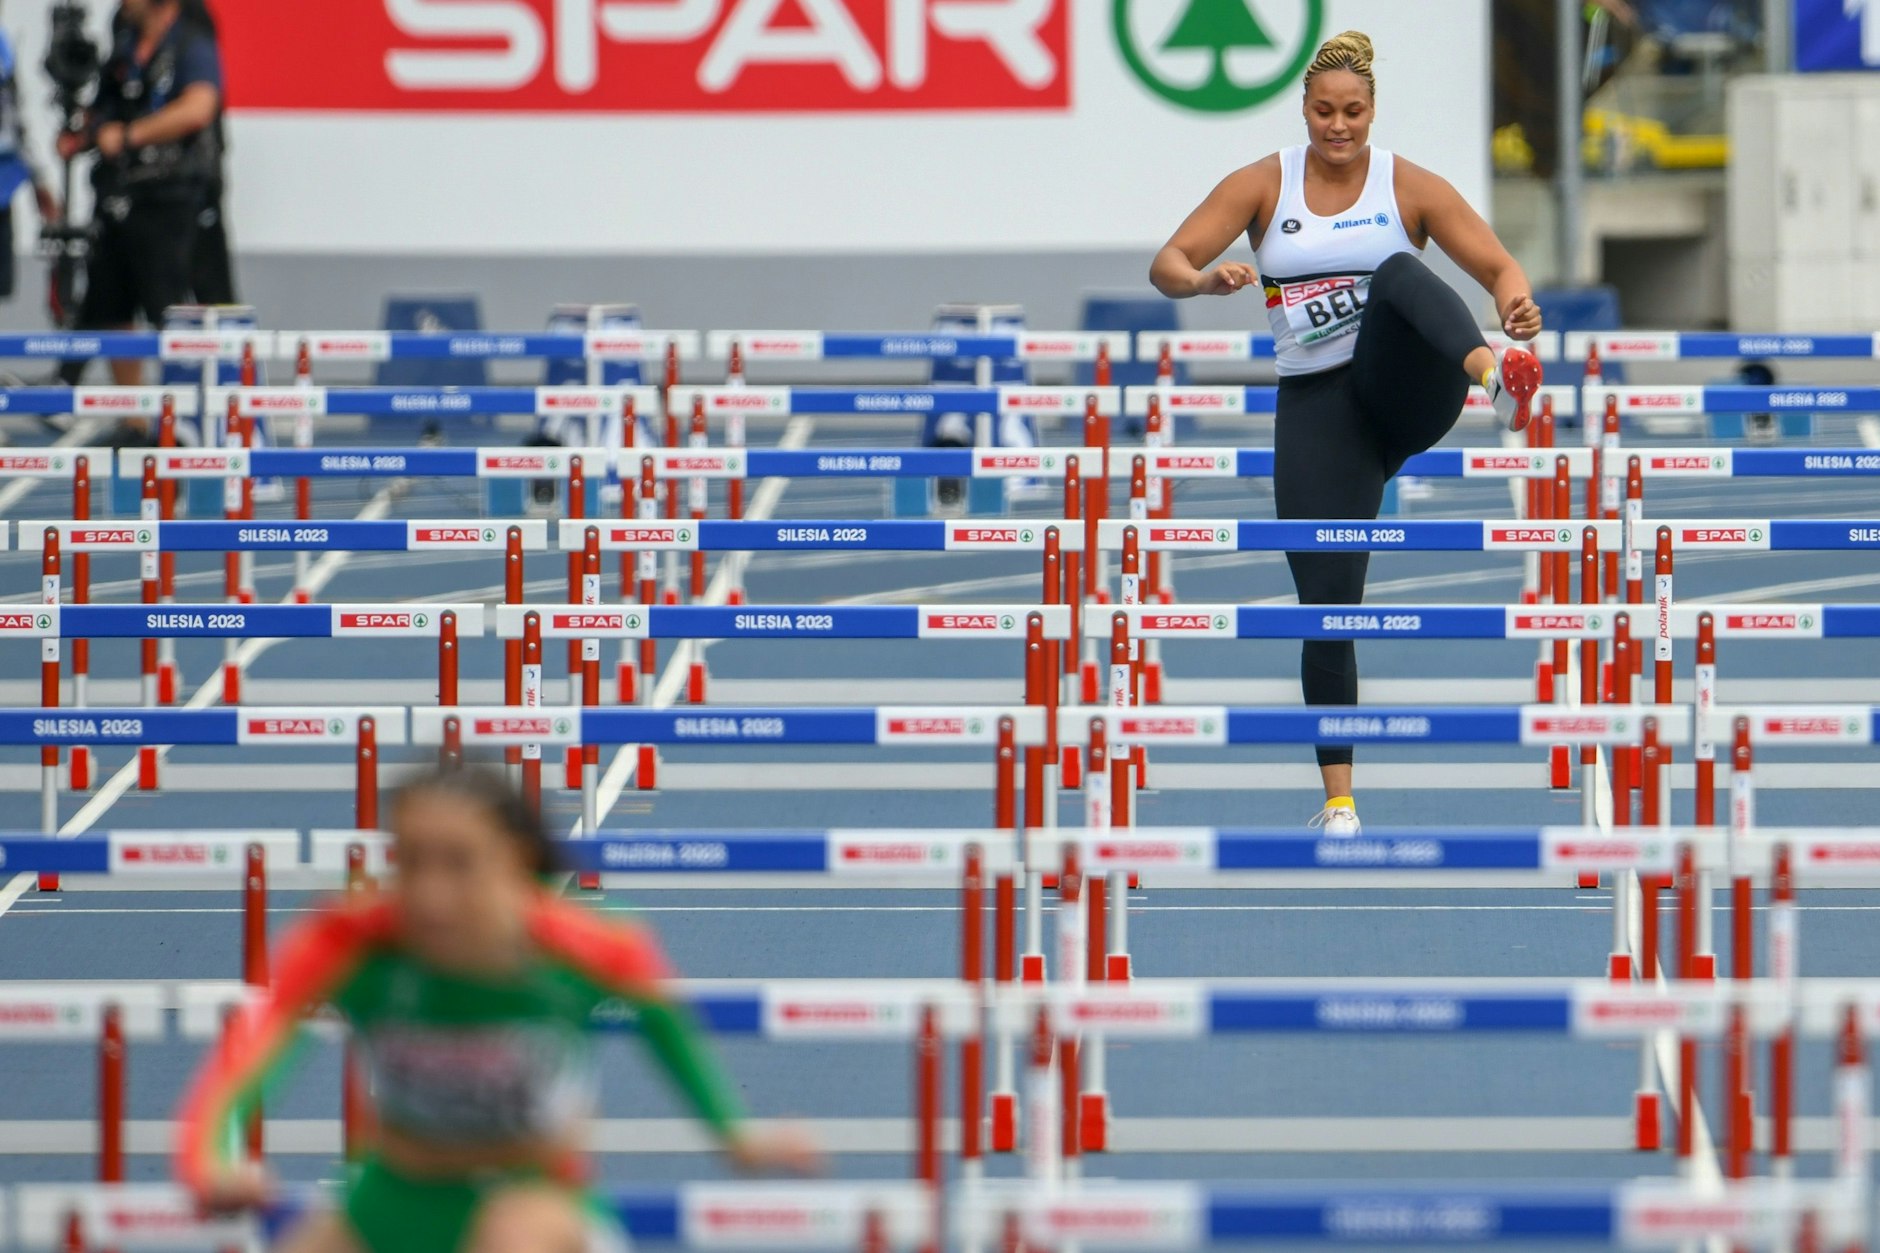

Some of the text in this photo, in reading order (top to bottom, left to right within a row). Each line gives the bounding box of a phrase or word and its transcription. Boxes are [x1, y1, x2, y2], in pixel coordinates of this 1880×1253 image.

[383, 0, 1057, 94] SPAR
[1332, 218, 1373, 230] Allianz
[321, 455, 406, 471] SILESIA 2023
[817, 456, 901, 471] SILESIA 2023
[992, 457, 1041, 469] SPAR
[1167, 457, 1215, 469] SPAR
[1483, 457, 1530, 469] SPAR
[1663, 457, 1710, 469] SPAR
[1804, 455, 1880, 470] SILESIA 202
[84, 530, 135, 543] SPAR
[238, 528, 329, 542] SILESIA 2023
[429, 529, 480, 542] SPAR
[625, 529, 675, 542] SPAR
[777, 528, 867, 542] SILESIA 2023
[967, 529, 1018, 542] SPAR
[1163, 529, 1214, 542] SPAR
[1315, 528, 1405, 542] SILESIA 2023
[1505, 529, 1555, 542] SPAR
[1696, 529, 1746, 542] SPAR
[1849, 528, 1880, 542] SILE
[147, 614, 245, 628] SILESIA 2023
[355, 614, 410, 627] SPAR
[567, 615, 623, 628] SPAR
[735, 614, 833, 629] SILESIA 2023
[942, 615, 997, 628] SPAR
[1155, 615, 1211, 628] SPAR
[1322, 616, 1421, 630] SILESIA 2023
[1529, 616, 1584, 629] SPAR
[1658, 595, 1669, 639] polanik
[1740, 615, 1795, 629] SPAR
[33, 718, 144, 735] SILESIA 2023
[264, 719, 325, 733] SPAR
[490, 719, 551, 733] SPAR
[674, 718, 785, 735] SILESIA 2023
[1319, 717, 1383, 735] SILESIA
